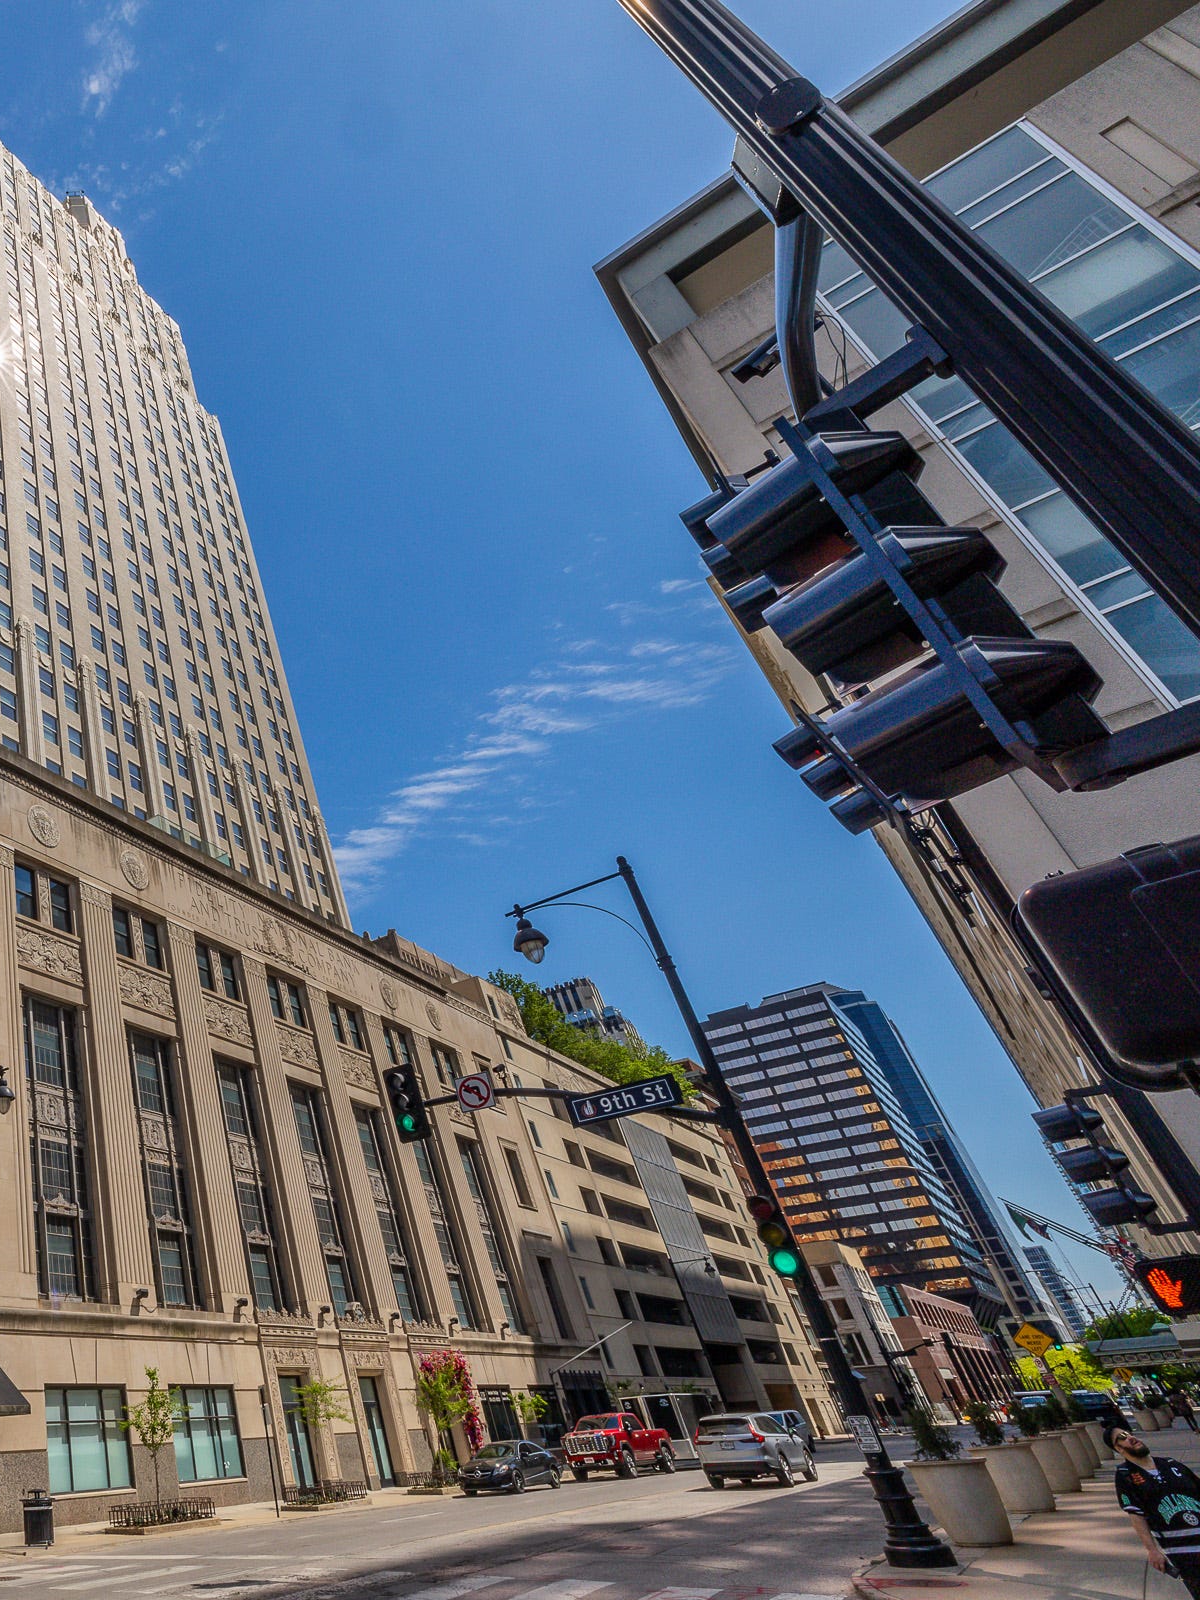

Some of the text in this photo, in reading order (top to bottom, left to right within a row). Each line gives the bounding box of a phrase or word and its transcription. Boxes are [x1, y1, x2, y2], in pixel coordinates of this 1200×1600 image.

[178, 870, 247, 919] FIDELITY
[257, 911, 324, 957] NONAL
[191, 896, 221, 922] AND
[299, 949, 357, 988] COMPANY
[600, 1084, 667, 1113] 9th St
[1171, 1467, 1182, 1477] C
